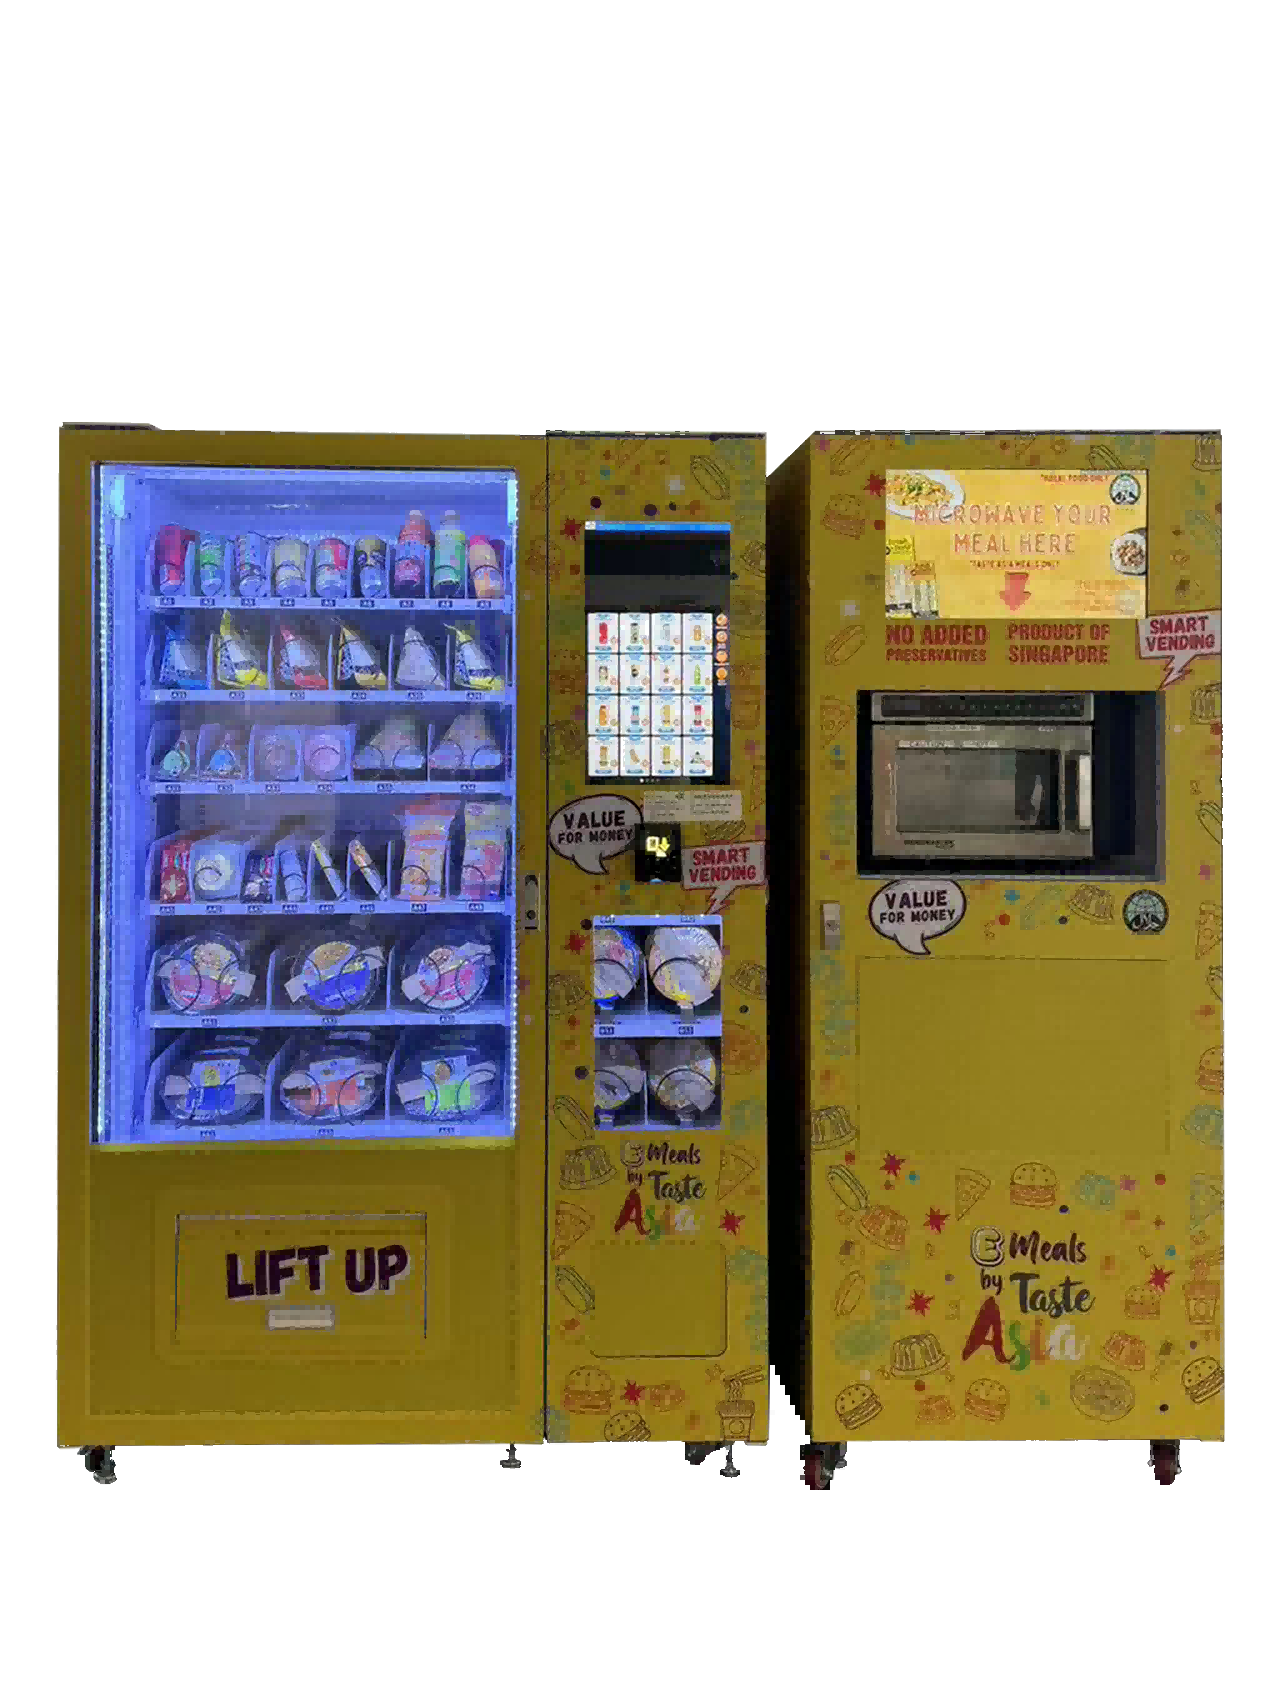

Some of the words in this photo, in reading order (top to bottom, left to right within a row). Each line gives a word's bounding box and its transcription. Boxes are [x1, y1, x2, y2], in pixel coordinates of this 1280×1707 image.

[914, 503, 1044, 524] MICROWAVE
[1053, 503, 1111, 524] YOUR
[954, 533, 1010, 553] MEAL
[1019, 533, 1076, 553] HERE
[885, 624, 914, 645] NO
[920, 624, 987, 645] ADDED
[1008, 623, 1085, 640] PRODUCT
[1089, 623, 1110, 640] OF
[1149, 615, 1209, 635] SMART
[1008, 644, 1110, 662] SINGAPORE
[1145, 634, 1215, 652] VENDING
[885, 648, 987, 662] PRESERVATIVES
[563, 810, 625, 829] VALUE
[557, 832, 583, 844] FOR
[589, 828, 633, 842] MONEY
[693, 847, 750, 866] SMART
[689, 865, 757, 882] VENDING
[885, 889, 948, 909] VALUE
[879, 911, 905, 924] FOR
[911, 909, 956, 922] MONEY
[647, 1141, 701, 1165] Meals
[648, 1170, 707, 1204] Taste
[1010, 1230, 1087, 1265] Meals
[226, 1245, 330, 1300] LIFT
[345, 1244, 410, 1294] UP
[980, 1268, 1003, 1296] by
[1009, 1272, 1096, 1319] Taste
